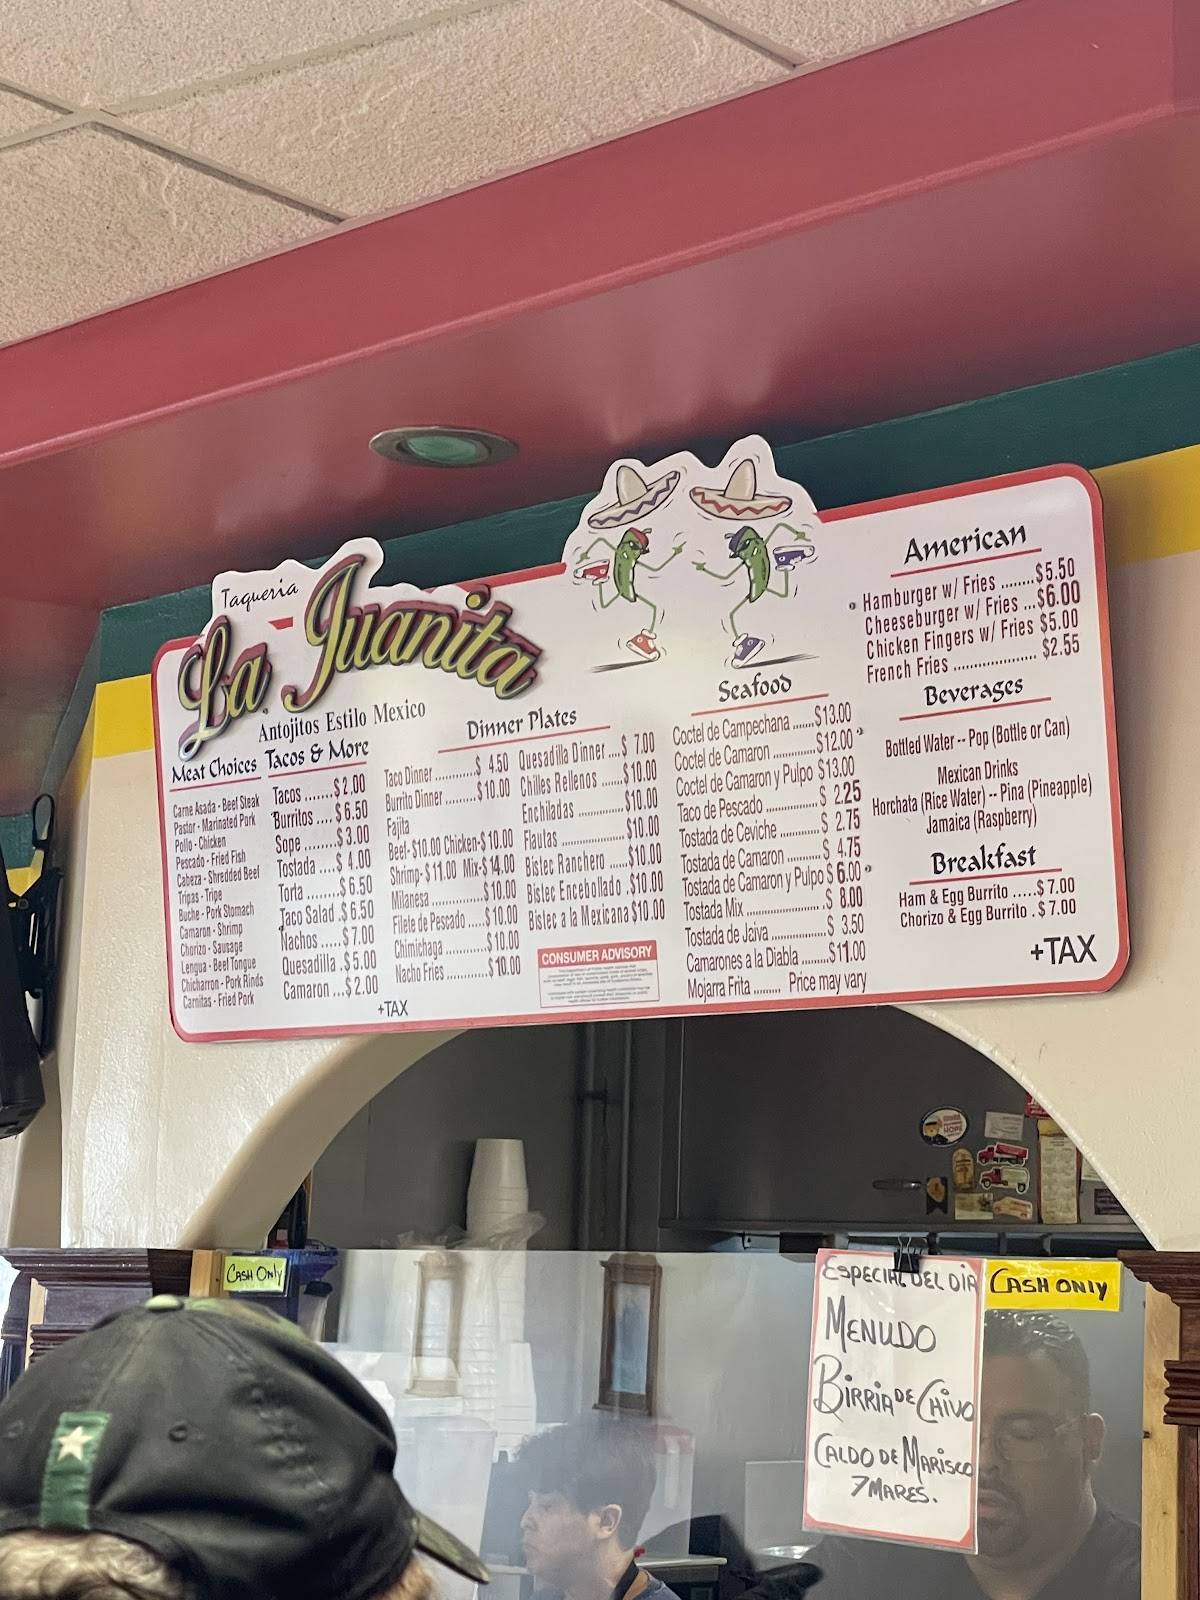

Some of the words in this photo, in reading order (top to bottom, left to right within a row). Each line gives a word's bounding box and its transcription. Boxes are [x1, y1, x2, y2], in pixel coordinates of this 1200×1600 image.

[904, 525, 1026, 564] American
[222, 578, 299, 612] Taqueria
[863, 585, 937, 612] Hamburger
[964, 575, 995, 595] Fries
[865, 606, 959, 635] Cheeseburger
[986, 596, 1018, 617] Fries
[281, 553, 543, 713] Juanita
[867, 636, 918, 659] Chicken
[925, 627, 974, 651] Fingers
[1001, 619, 1033, 639] Fries
[867, 659, 911, 684] French
[917, 656, 948, 676] Fries
[178, 615, 273, 761] La
[718, 672, 791, 702] Seafood
[924, 678, 1024, 705] Beverages
[258, 712, 320, 744] Antojitos
[326, 708, 367, 732] Estilo
[374, 701, 426, 726] Mexico
[466, 717, 523, 740] Dinner
[529, 707, 577, 729] Plates
[673, 725, 704, 746] Coctel
[707, 723, 719, 741] de
[722, 714, 789, 742] Campechana
[886, 735, 921, 758] Bottled
[924, 733, 954, 752] Water
[969, 728, 989, 751] Pop
[992, 724, 1026, 748] (Bottle
[1031, 727, 1040, 738] or
[1044, 716, 1070, 739] Can)
[265, 749, 305, 769] Tacos
[311, 744, 323, 762] &
[329, 741, 368, 761] More
[518, 746, 569, 771] Quesadilla
[572, 742, 605, 762] Dinner
[172, 765, 205, 783] Meat
[209, 757, 257, 778] Choices
[384, 767, 403, 788] Taco
[405, 767, 432, 786] Dinner
[676, 776, 707, 797] Coctel
[710, 775, 722, 792] de
[726, 770, 771, 791] Camaron
[774, 770, 779, 791] y
[783, 762, 813, 787] Pulpo
[938, 765, 981, 785] Mexican
[985, 759, 1018, 779] Drinks
[273, 786, 301, 805] Tacos
[521, 776, 550, 797] Chilles
[555, 771, 596, 793] Rellenos
[873, 794, 917, 816] Horchata
[921, 792, 947, 815] (Rice
[950, 786, 985, 810] Water)
[1001, 784, 1024, 802] Pina
[1028, 773, 1092, 799] (Pineapple)
[195, 800, 216, 814] Asada
[223, 798, 238, 811] Beef
[240, 794, 259, 808] Steak
[386, 793, 412, 812] Burrito
[415, 790, 442, 808] Dinner
[522, 803, 574, 824] Enchiladas
[678, 802, 700, 823] Taco
[704, 800, 716, 820] de
[719, 795, 763, 818] Pescado
[202, 813, 237, 831] Marinated
[240, 812, 255, 826] Pork
[274, 810, 313, 829] Burritos
[387, 818, 409, 839] Fajita
[927, 813, 970, 834] Jamaica
[974, 805, 1037, 834] (Raspberry)
[199, 835, 226, 849] Chicken
[276, 834, 300, 858] Sope
[524, 831, 557, 850] Flautas
[680, 828, 719, 848] Tostada
[721, 827, 734, 844] de
[736, 822, 777, 842] Ceviche
[278, 856, 315, 878] Tostada
[525, 857, 555, 877] Bistec
[558, 852, 604, 874] Ranchero
[681, 853, 720, 873] Tostada
[723, 852, 735, 868] de
[738, 848, 784, 867] Camaron
[930, 843, 1036, 874] Breakfast
[279, 882, 303, 903] Torta
[527, 882, 555, 904] Bistec
[560, 876, 621, 901] Encebollado
[900, 892, 925, 907] Ham
[930, 890, 938, 905] &
[943, 889, 963, 905] Egg
[968, 884, 1008, 901] Burrito
[280, 906, 302, 926] Taco
[306, 903, 334, 923] Salad
[529, 910, 557, 931] Bistec
[561, 911, 567, 927] a
[570, 905, 577, 927] la
[581, 904, 629, 925] Mexicana
[684, 901, 722, 921] Tostada
[726, 898, 744, 917] Mix
[901, 911, 943, 927] Chorizo
[948, 909, 956, 924] &
[961, 909, 982, 925] Egg
[987, 904, 1027, 921] Burrito
[281, 930, 317, 951] Nachos
[685, 926, 724, 947] Tostada
[727, 924, 739, 942] de
[541, 950, 600, 965] CONSUMER
[602, 946, 652, 960] ADVISORY
[687, 952, 742, 973] Camarones
[746, 956, 752, 968] a
[754, 948, 763, 967] la
[766, 945, 798, 966] Diabla
[1031, 934, 1097, 965] +TAX
[283, 956, 335, 976] Quesadilla
[688, 976, 726, 1002] Mojarra
[728, 976, 750, 995] Frita
[789, 972, 816, 993] Price
[819, 976, 842, 994] may
[845, 971, 866, 993] vary
[378, 1000, 407, 1017] +TAX
[826, 1295, 936, 1353] MENUDO
